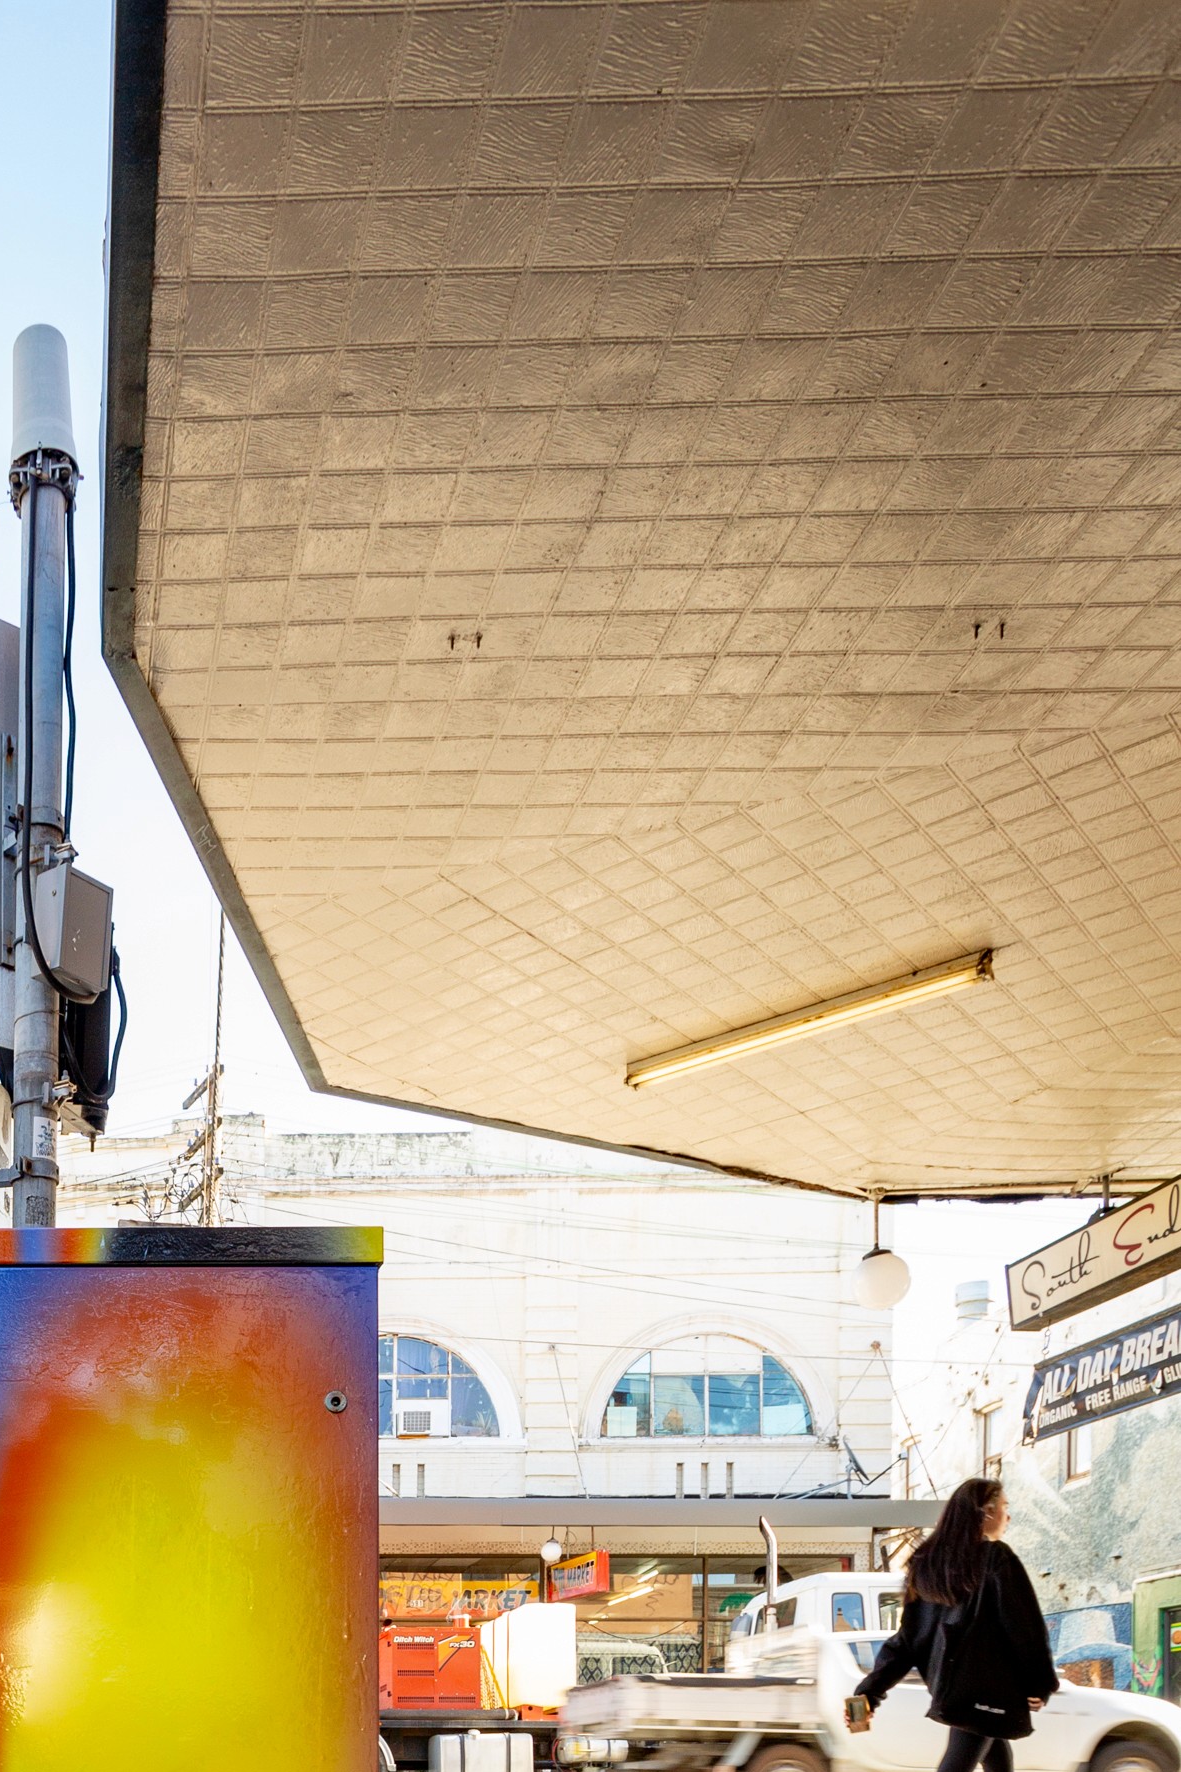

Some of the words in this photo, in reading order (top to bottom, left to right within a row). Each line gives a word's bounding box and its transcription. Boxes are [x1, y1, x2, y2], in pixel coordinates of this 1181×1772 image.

[1022, 1230, 1100, 1311] South
[1113, 1184, 1181, 1266] End
[1041, 1363, 1072, 1407] ALL
[1075, 1344, 1120, 1393] DAY
[1120, 1319, 1181, 1377] BREA
[1039, 1401, 1078, 1428] ORGANIC
[1085, 1388, 1112, 1411] FREE
[1112, 1375, 1148, 1401] RANGE
[393, 1635, 413, 1643] Ditch
[414, 1635, 435, 1643] Witch
